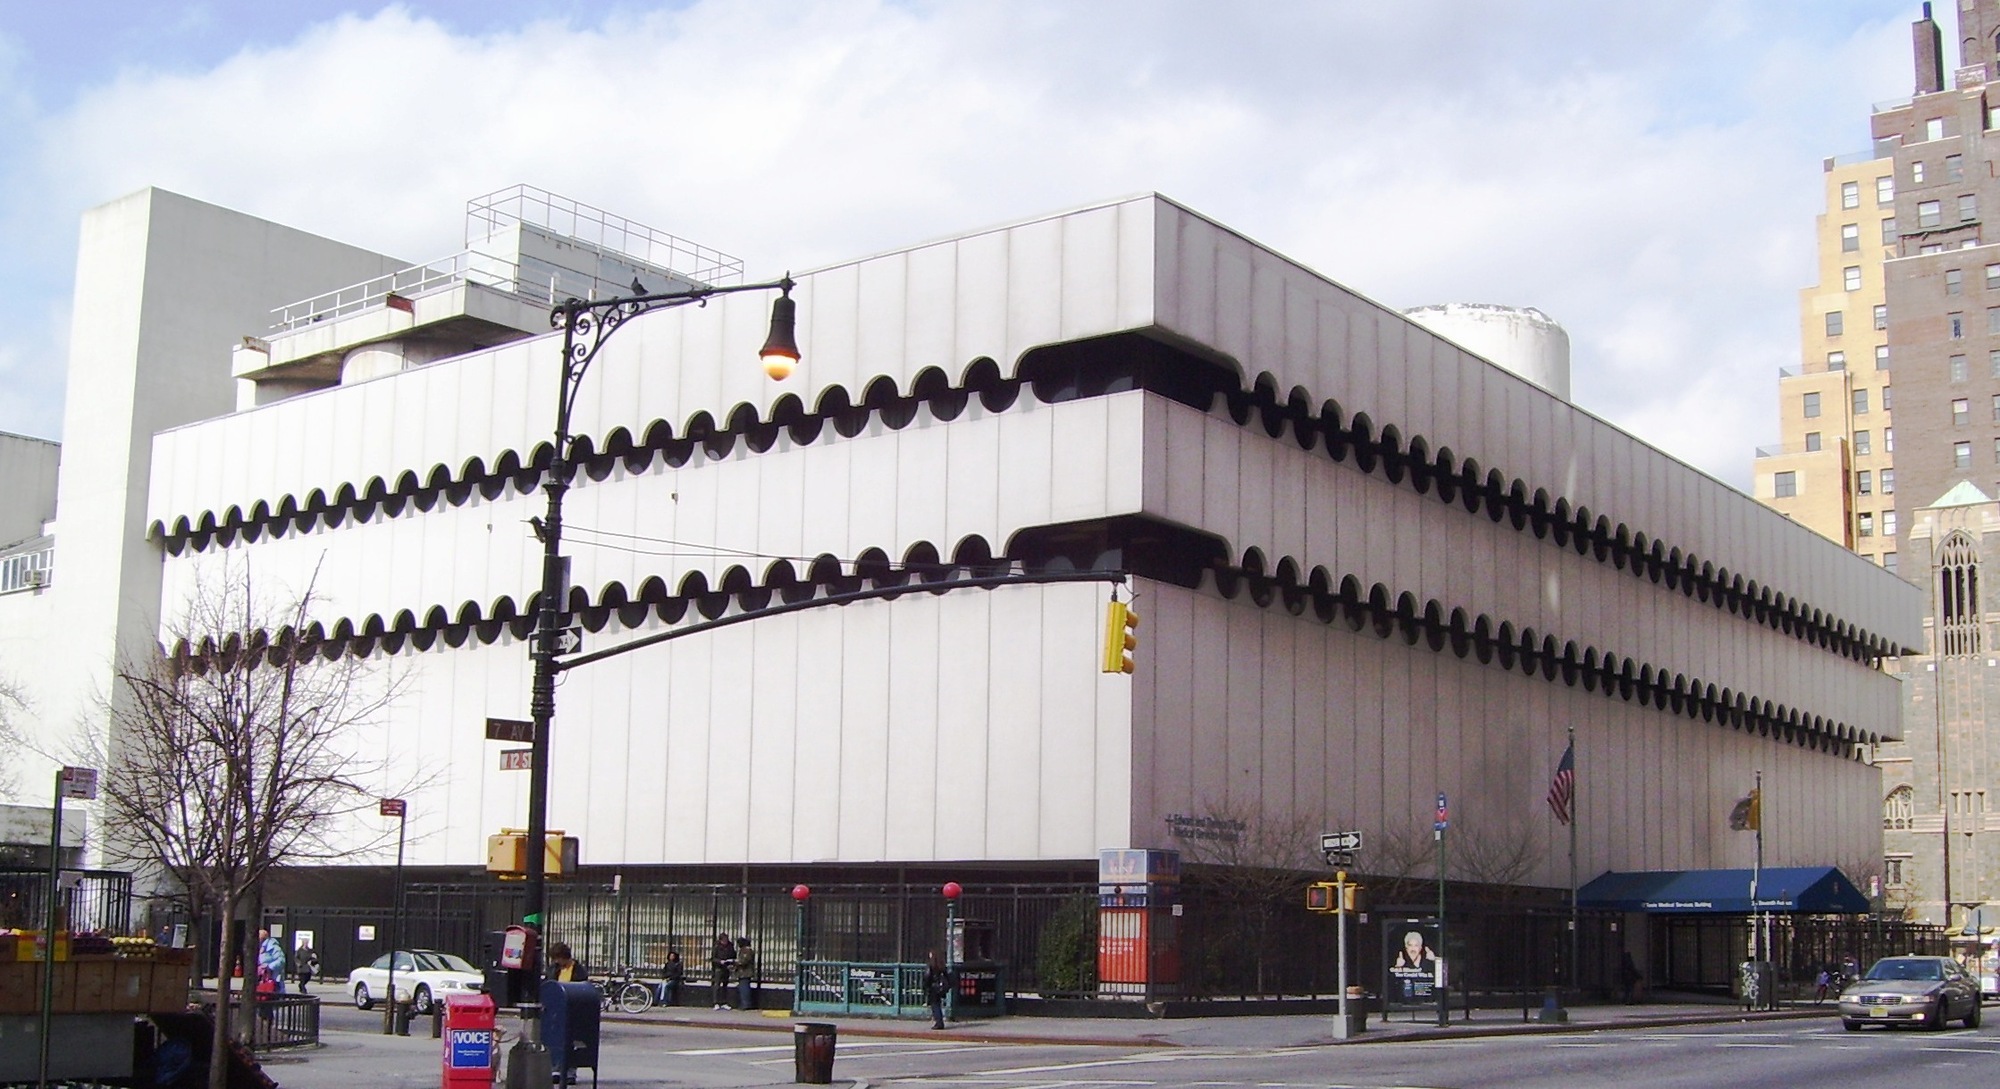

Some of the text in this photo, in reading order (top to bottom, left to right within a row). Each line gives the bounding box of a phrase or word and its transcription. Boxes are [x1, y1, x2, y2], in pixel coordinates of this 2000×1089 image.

[494, 723, 525, 740] 7 AV
[510, 752, 520, 769] 12
[850, 968, 875, 978] Subway
[456, 1032, 489, 1043] VOICE
